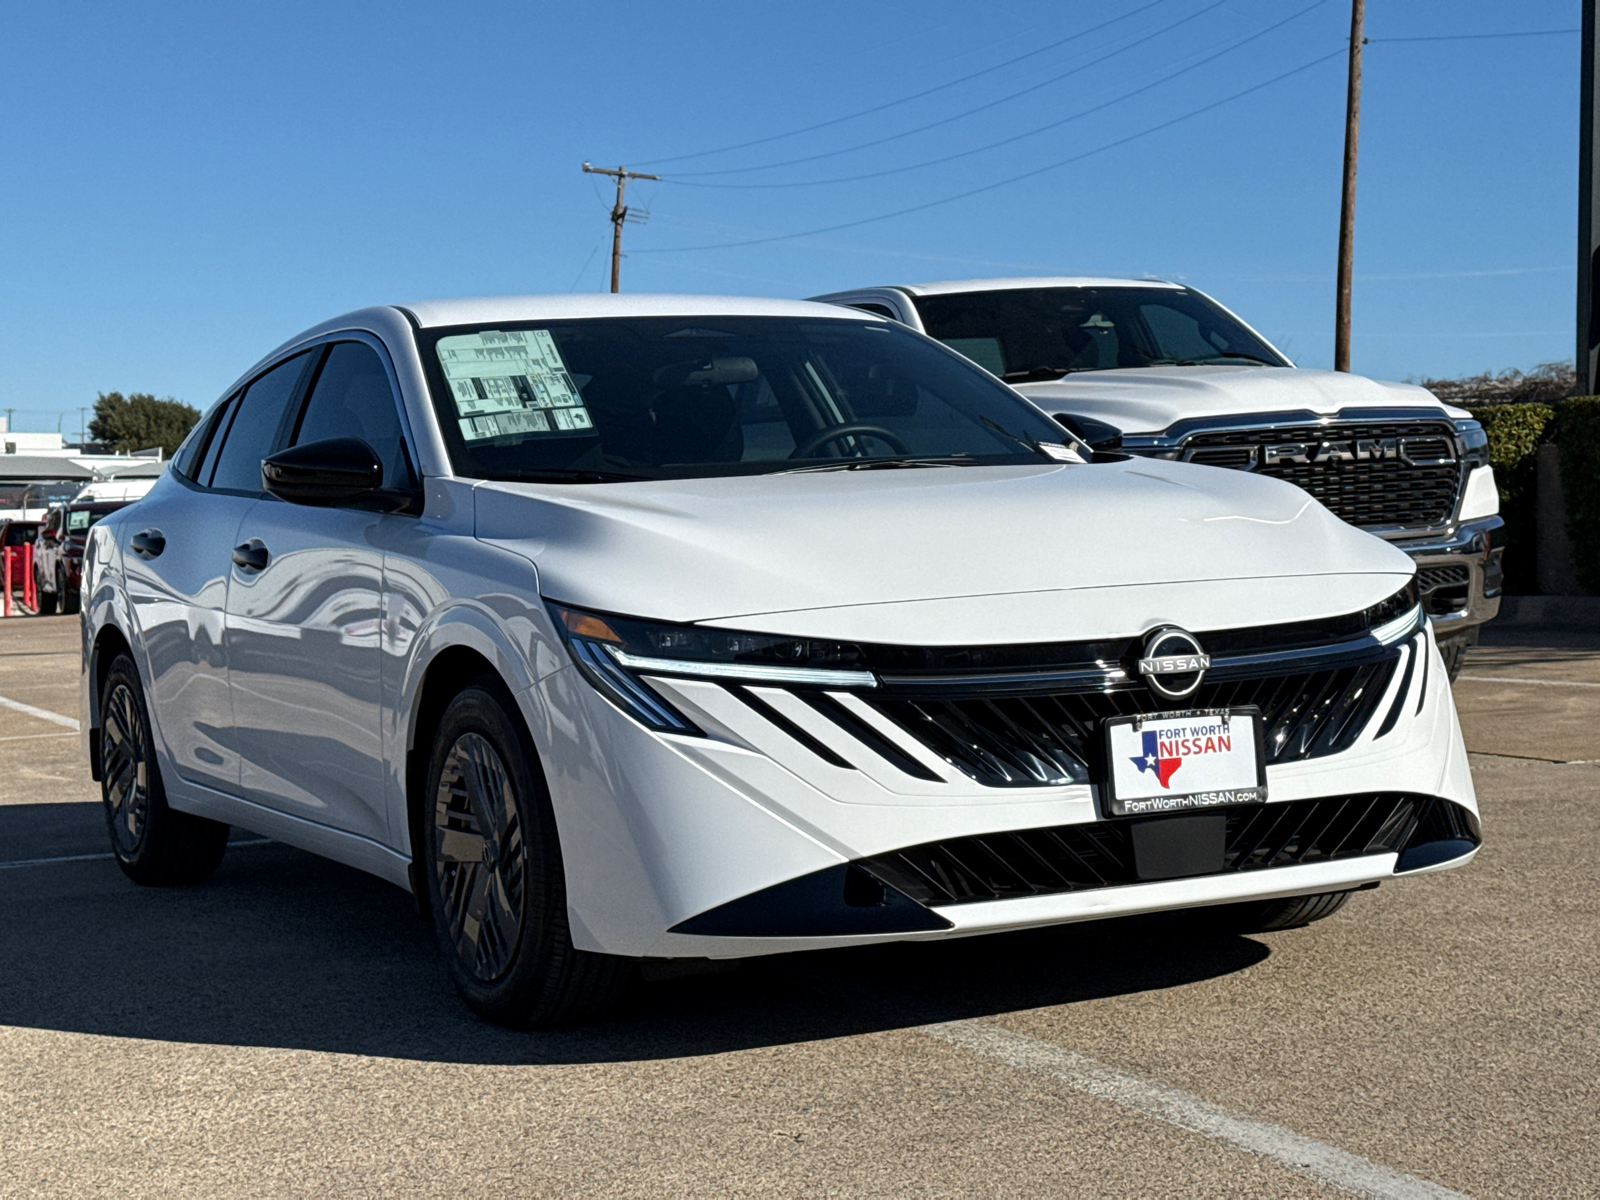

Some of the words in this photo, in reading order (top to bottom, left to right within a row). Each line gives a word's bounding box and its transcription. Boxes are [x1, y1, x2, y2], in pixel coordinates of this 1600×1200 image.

[1265, 438, 1398, 464] RAM
[1140, 657, 1209, 672] NISSAN
[1136, 713, 1158, 722] FORT
[1162, 710, 1192, 719] WORTH
[1204, 708, 1230, 716] TEXAS
[1158, 727, 1187, 740] FORT
[1190, 723, 1230, 737] WORTH
[1159, 735, 1231, 758] NISSAN
